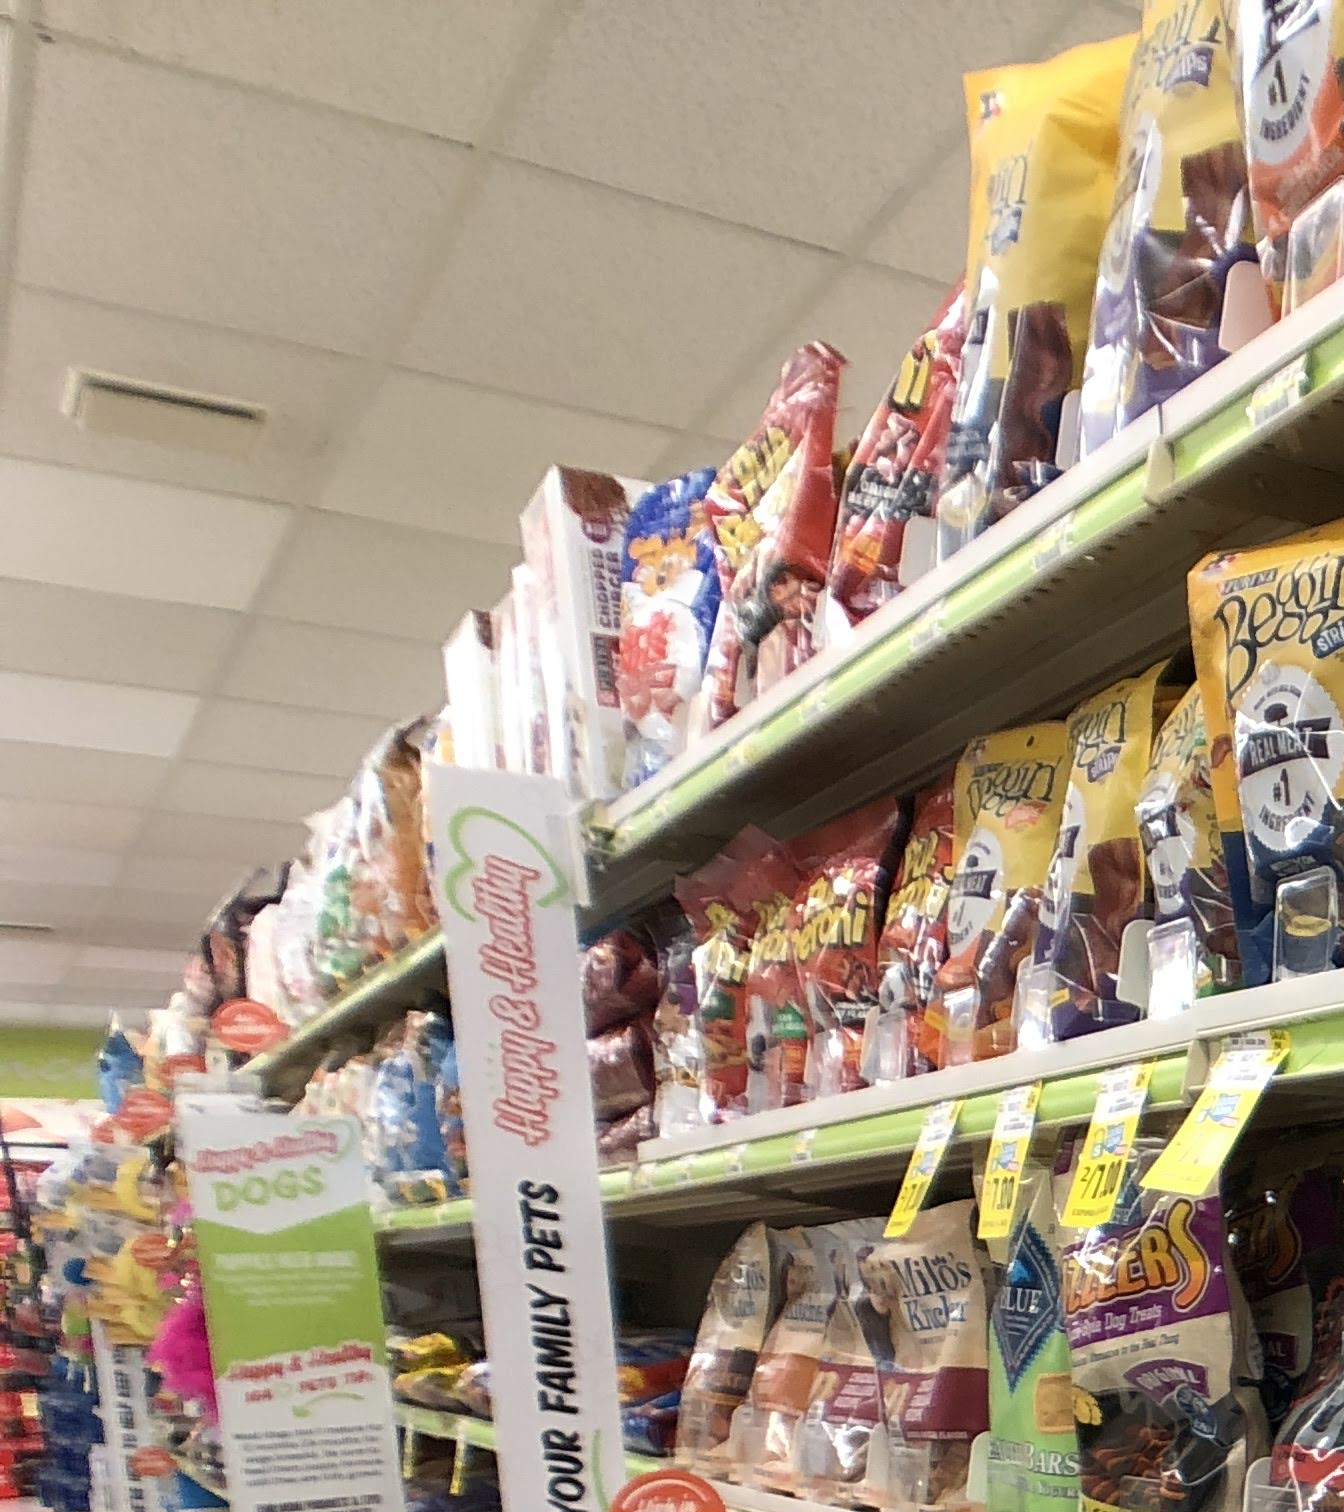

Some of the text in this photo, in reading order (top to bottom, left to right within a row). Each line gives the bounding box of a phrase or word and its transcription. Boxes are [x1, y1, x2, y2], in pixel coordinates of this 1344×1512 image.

[211, 1164, 325, 1213] DOGS
[516, 1179, 561, 1277] PETS
[522, 1281, 577, 1414] FAMILY
